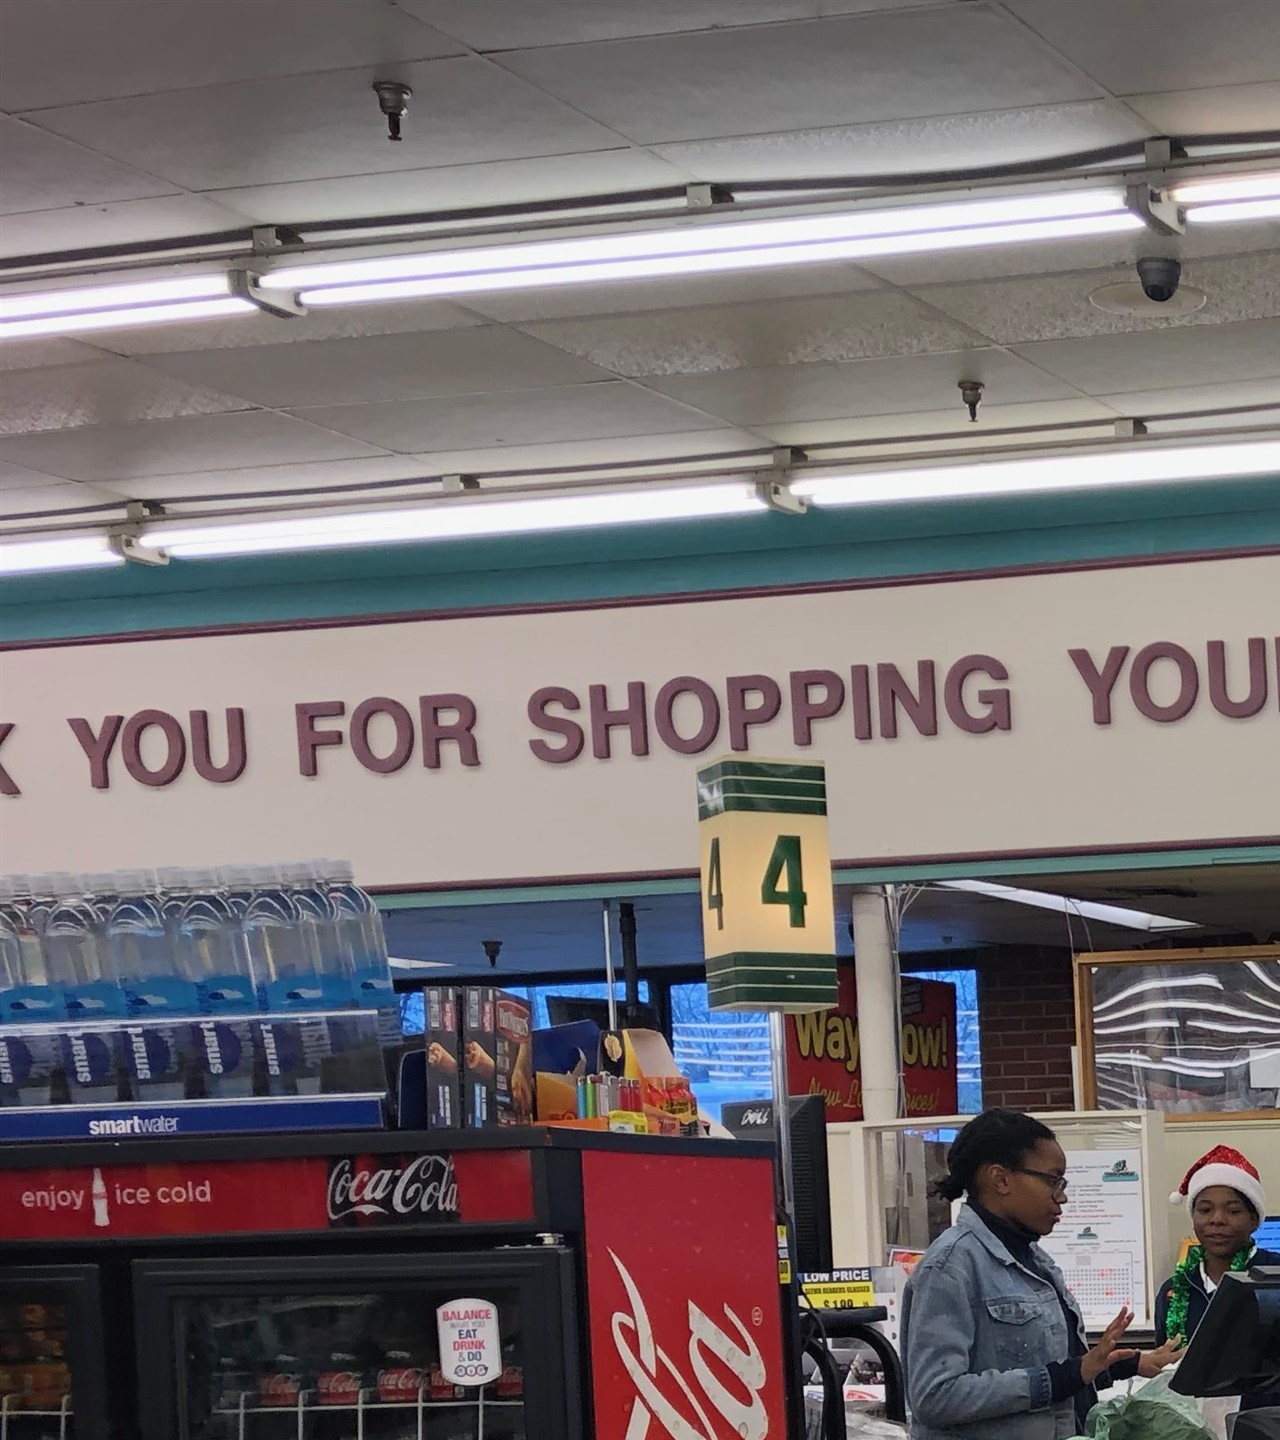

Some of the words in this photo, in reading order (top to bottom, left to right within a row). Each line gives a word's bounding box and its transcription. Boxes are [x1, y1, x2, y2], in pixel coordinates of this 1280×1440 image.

[68, 706, 248, 790] YOU
[297, 693, 481, 778] FOR
[528, 653, 1012, 764] SHOPPING
[706, 835, 726, 932] 4
[761, 834, 808, 929] 4
[902, 1016, 948, 1068] ow!
[89, 1114, 180, 1135] smartwater
[21, 1187, 84, 1211] enjoy
[115, 1183, 150, 1205] ice
[156, 1181, 212, 1205] cold
[327, 1155, 460, 1221] Coca-Cola
[804, 1271, 830, 1283] LOW
[832, 1269, 870, 1282] PRICE
[442, 1308, 492, 1321] BALANCE
[452, 1339, 486, 1351] DRINK
[458, 1328, 477, 1340] EAT
[458, 1352, 466, 1363] &
[468, 1351, 482, 1362] DO
